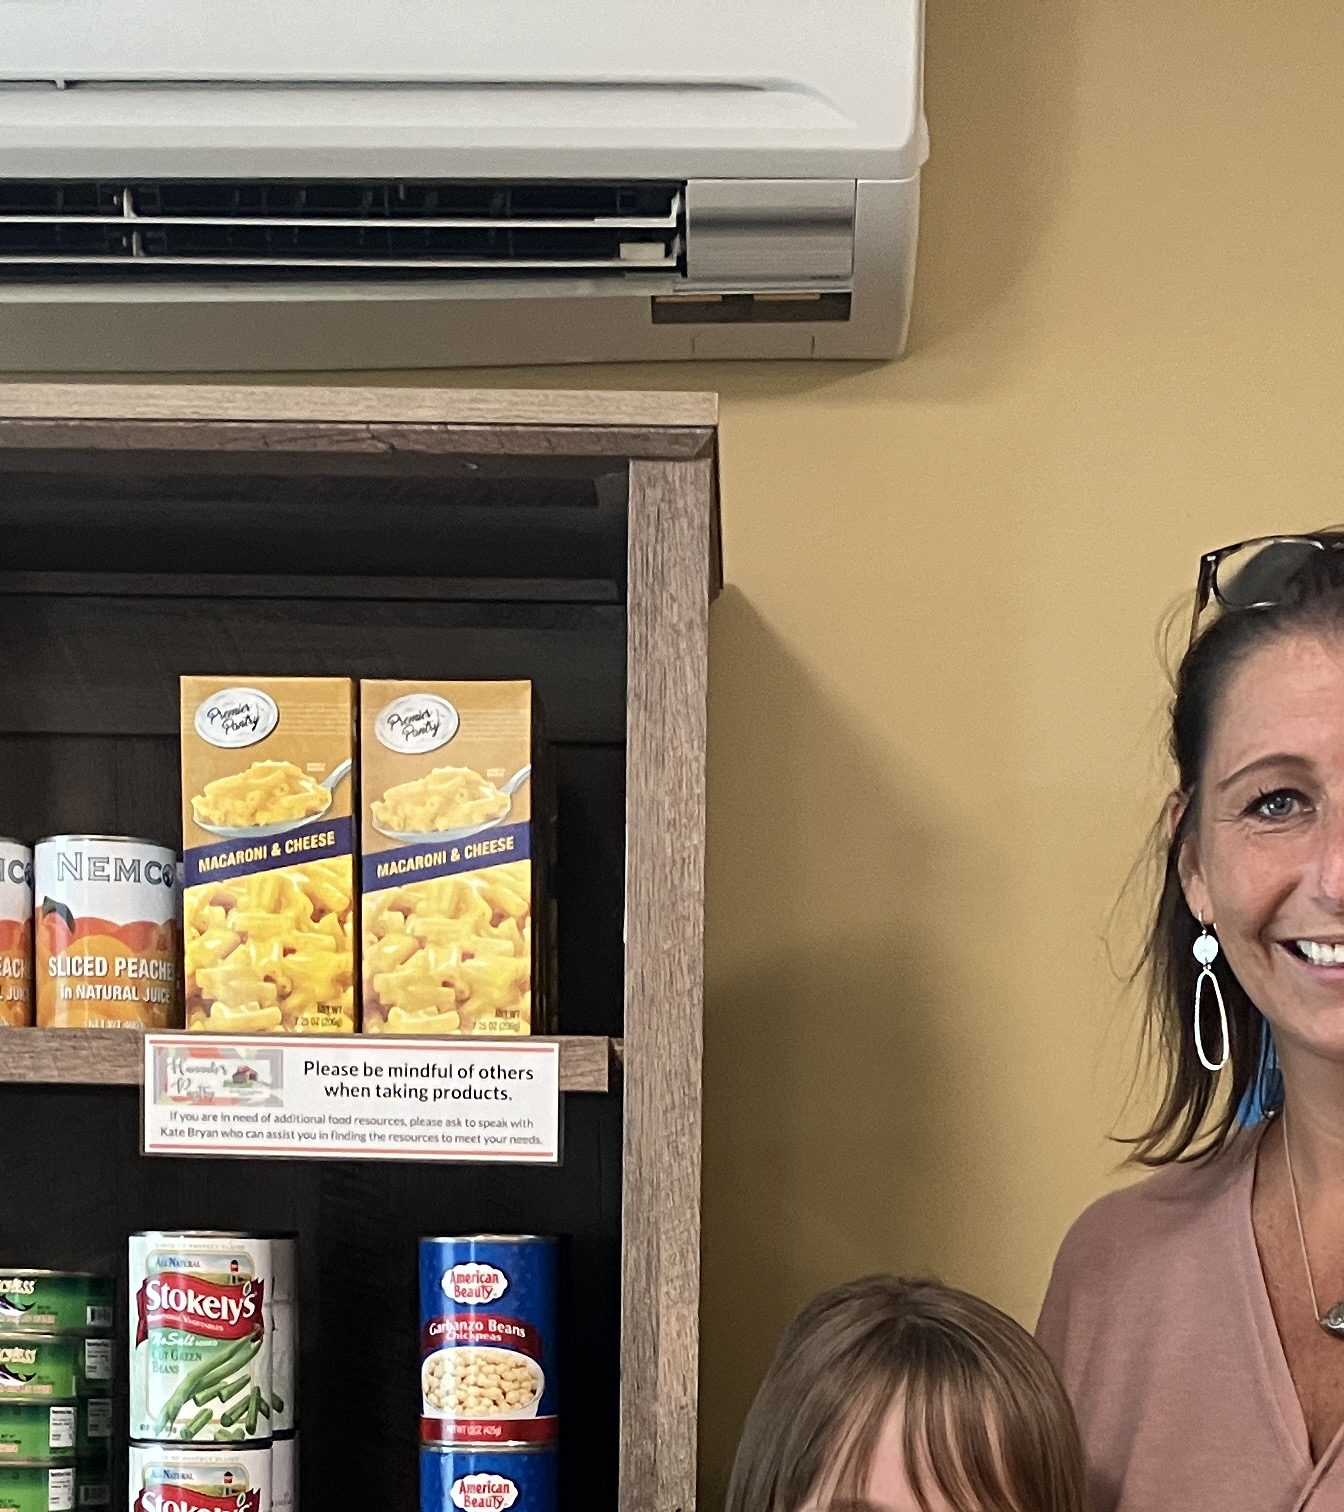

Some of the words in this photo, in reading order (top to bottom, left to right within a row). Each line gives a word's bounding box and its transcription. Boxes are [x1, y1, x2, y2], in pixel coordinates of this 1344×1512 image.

[198, 848, 268, 872] MACARONI
[271, 844, 282, 858] &
[285, 830, 336, 853] CHEESE
[376, 851, 447, 878] MACARONI
[451, 848, 460, 863] &
[464, 836, 515, 860] CHEESE
[57, 852, 174, 888] NEMCO
[48, 956, 109, 977] SLICED
[76, 986, 139, 1001] NATURAL
[304, 1060, 359, 1077] Please
[363, 1062, 383, 1077] be
[388, 1063, 453, 1078] mindful
[457, 1064, 475, 1079] of
[479, 1065, 534, 1080] others
[324, 1082, 371, 1098] when
[376, 1084, 429, 1101] taking
[433, 1085, 513, 1102] products.
[180, 1112, 199, 1122] you
[201, 1113, 218, 1122] are
[221, 1112, 231, 1122] in
[233, 1112, 258, 1123] need
[261, 1113, 271, 1123] of
[274, 1113, 326, 1124] additional
[328, 1115, 351, 1125] food
[354, 1116, 407, 1127] resources,
[410, 1117, 443, 1128] please
[445, 1117, 462, 1127] ask
[465, 1118, 476, 1128] to
[478, 1119, 508, 1129] speak
[511, 1119, 534, 1129] with
[160, 1127, 185, 1137] Kate
[188, 1127, 219, 1140] Bryan
[221, 1128, 243, 1138] who
[245, 1130, 264, 1139] can
[266, 1129, 295, 1139] assist
[297, 1131, 316, 1141] you
[319, 1130, 329, 1139] in
[331, 1130, 366, 1143] finding
[369, 1132, 386, 1142] the
[388, 1132, 439, 1143] resources
[442, 1135, 453, 1143] to
[455, 1135, 481, 1144] meet
[484, 1136, 507, 1146] your
[450, 1270, 500, 1284] American
[454, 1285, 494, 1300] Beauty
[145, 1280, 258, 1325] Stokely's
[429, 1319, 483, 1336] Garbanzo
[488, 1319, 526, 1338] Beans
[446, 1332, 502, 1342] Chickpeas
[459, 1480, 510, 1494] American
[464, 1495, 504, 1509] Beauty
